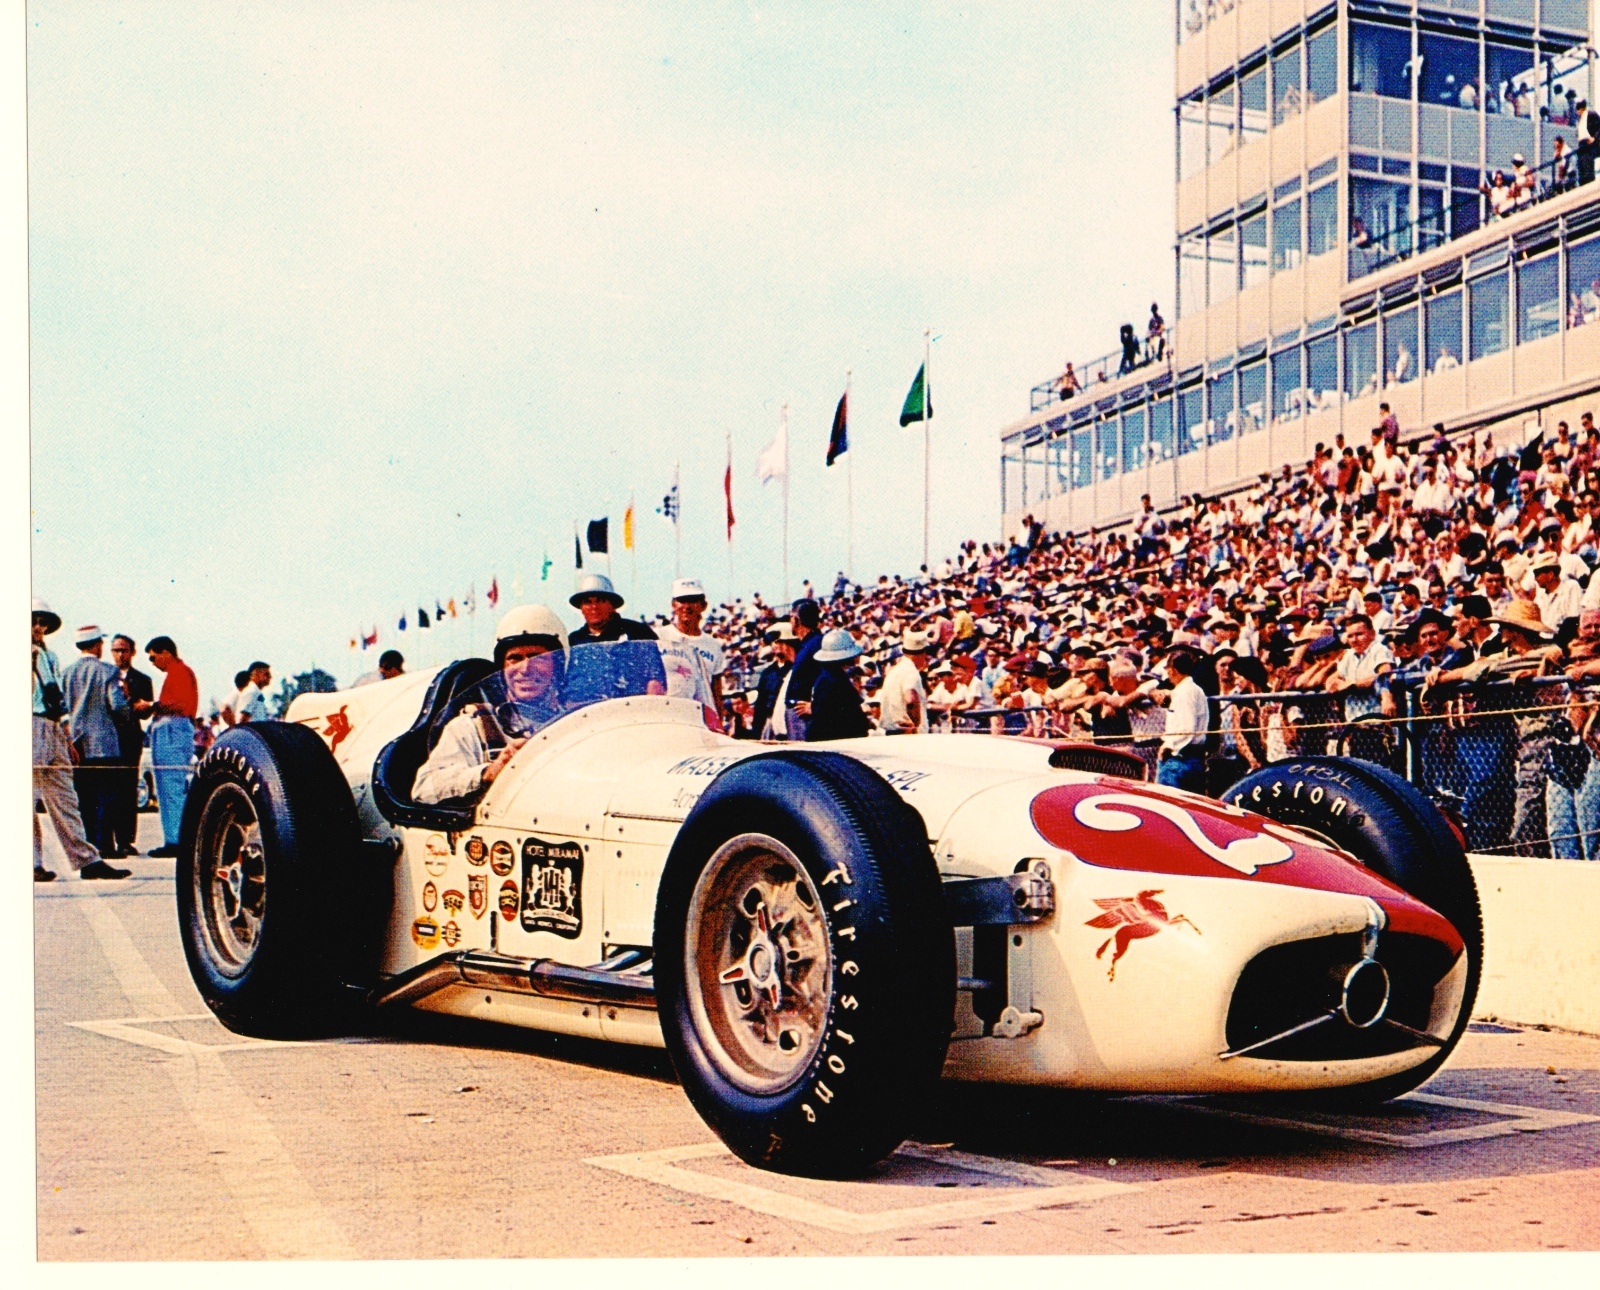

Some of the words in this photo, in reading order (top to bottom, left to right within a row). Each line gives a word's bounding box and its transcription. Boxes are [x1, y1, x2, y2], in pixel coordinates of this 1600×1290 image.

[666, 756, 740, 775] MASS
[1234, 781, 1349, 817] reston
[801, 861, 860, 1123] Firestone
